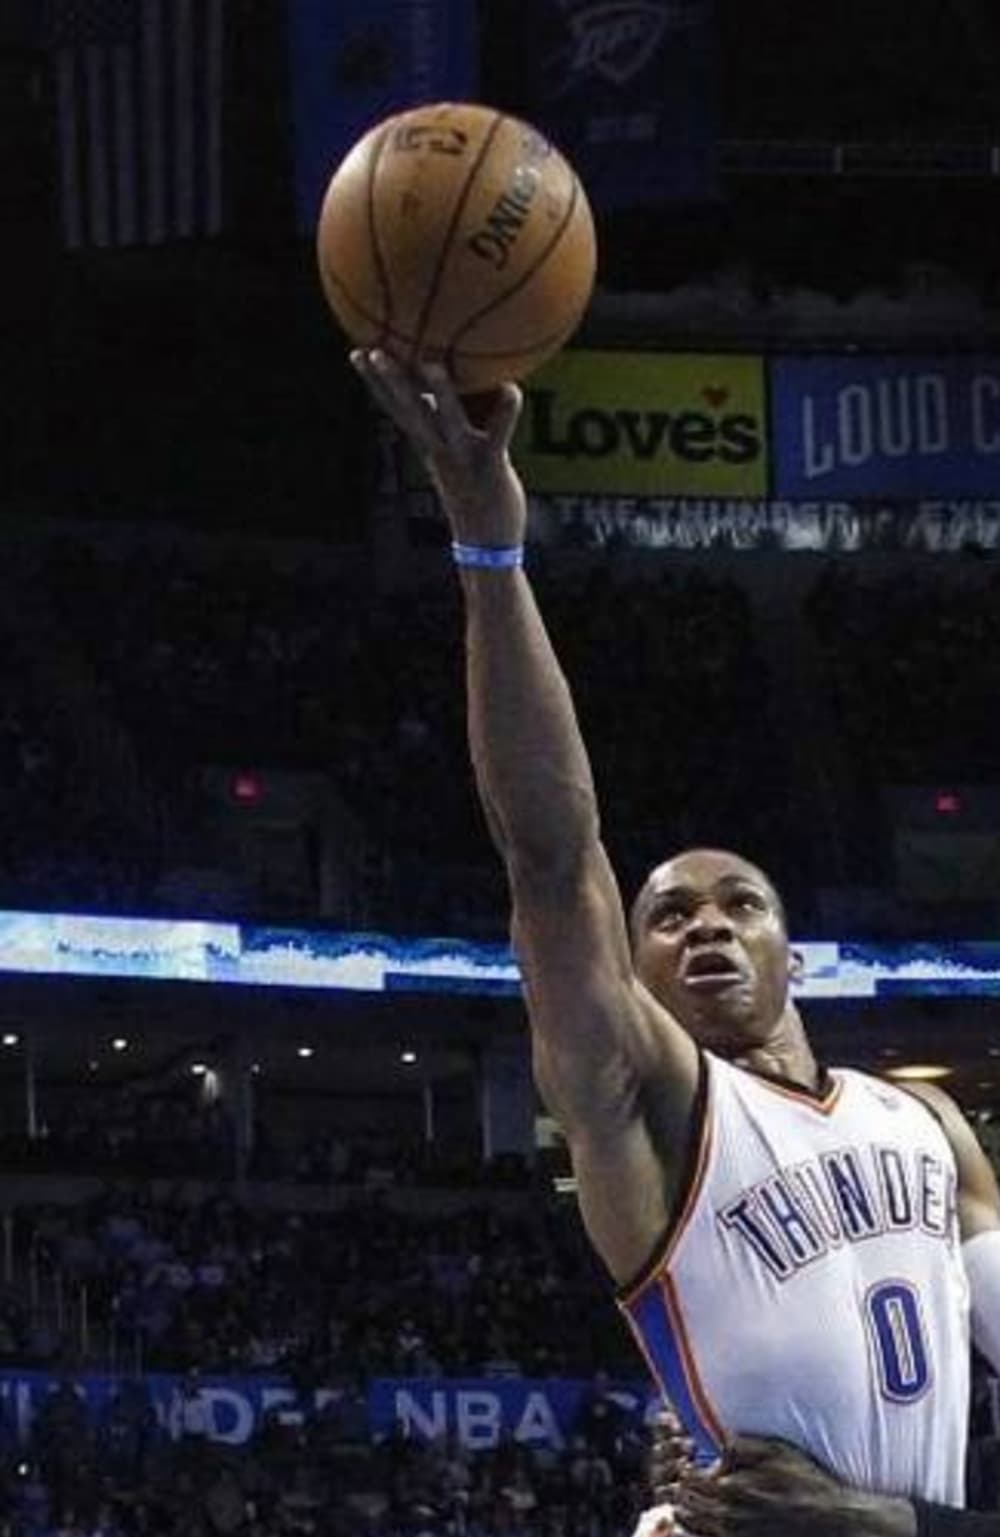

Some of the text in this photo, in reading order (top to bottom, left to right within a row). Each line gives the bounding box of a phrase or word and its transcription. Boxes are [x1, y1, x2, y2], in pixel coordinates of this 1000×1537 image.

[803, 376, 948, 480] LOUD
[716, 1143, 957, 1282] THUNDE
[866, 1278, 934, 1405] 0
[393, 1388, 566, 1448] NBA
